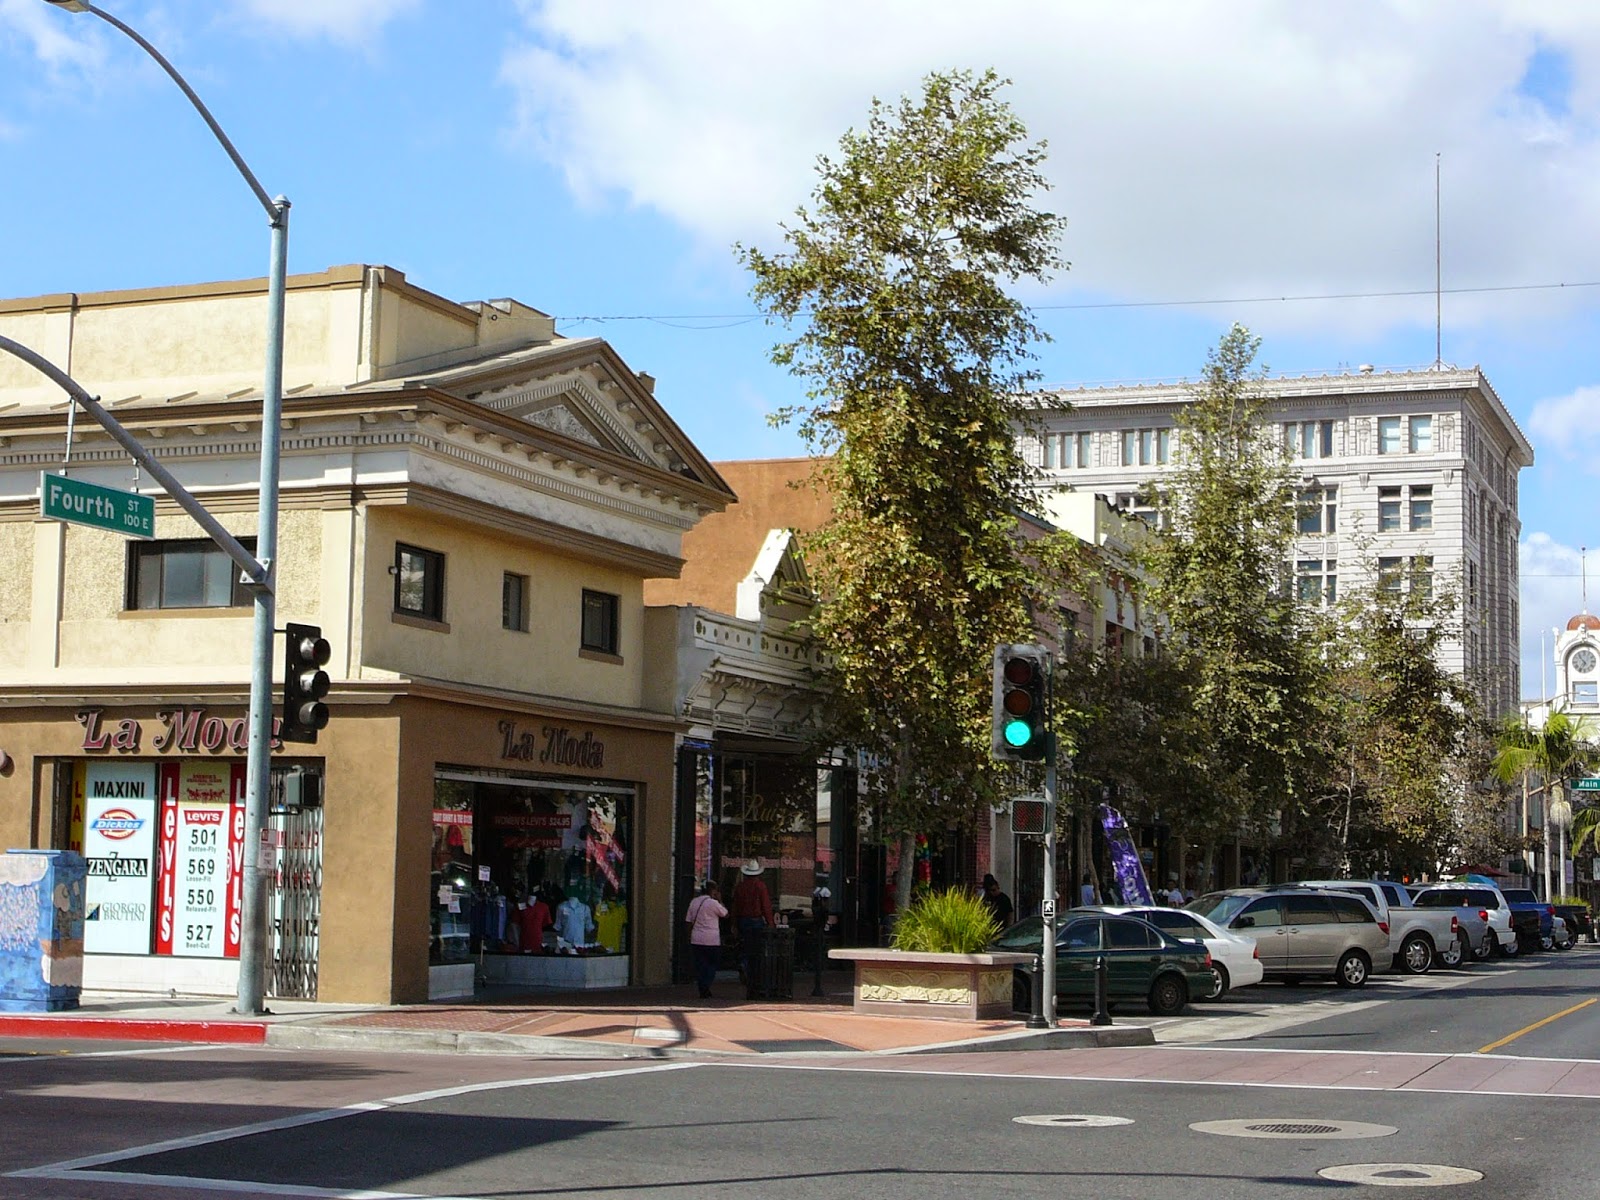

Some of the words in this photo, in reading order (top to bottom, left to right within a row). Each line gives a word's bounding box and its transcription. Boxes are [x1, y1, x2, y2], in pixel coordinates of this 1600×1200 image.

[50, 485, 114, 519] Fourth
[128, 500, 140, 512] ST
[124, 514, 140, 527] 100
[143, 518, 149, 529] E
[75, 708, 138, 751] La
[498, 721, 535, 761] La
[540, 727, 604, 769] Moda
[94, 781, 145, 798] MAXINI
[95, 820, 141, 829] Dickies
[191, 829, 216, 845] 501
[88, 859, 146, 876] ZENGARA
[188, 859, 215, 875] 569
[187, 889, 214, 905] 550
[102, 902, 146, 914] GIORGIO
[103, 910, 144, 922] BRUTINI
[186, 925, 213, 941] 527
